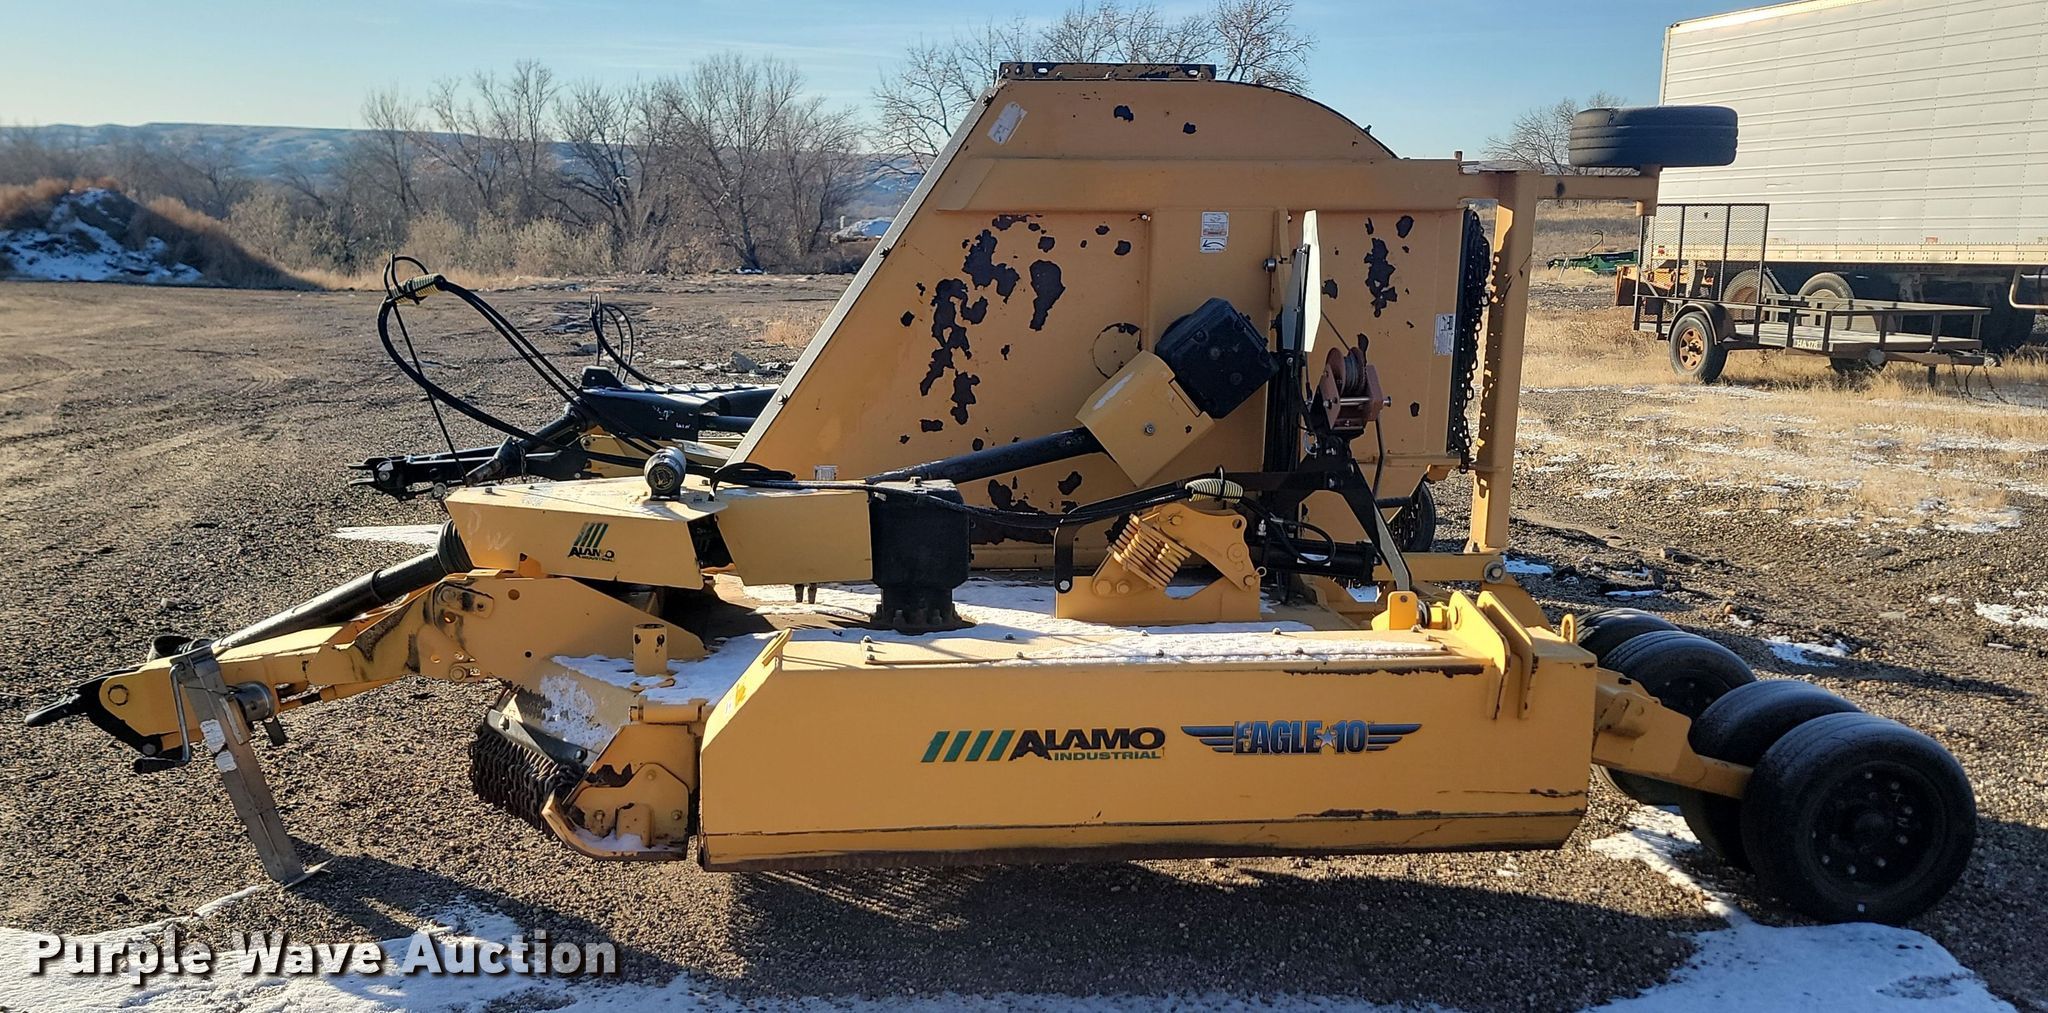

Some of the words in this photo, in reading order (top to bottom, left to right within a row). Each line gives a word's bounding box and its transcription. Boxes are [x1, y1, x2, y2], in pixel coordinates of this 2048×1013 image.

[1008, 727, 1166, 761] ALAMO
[1234, 720, 1322, 754] EAGLE
[1334, 720, 1368, 754] 10
[1054, 750, 1161, 761] INDUSTRIAL
